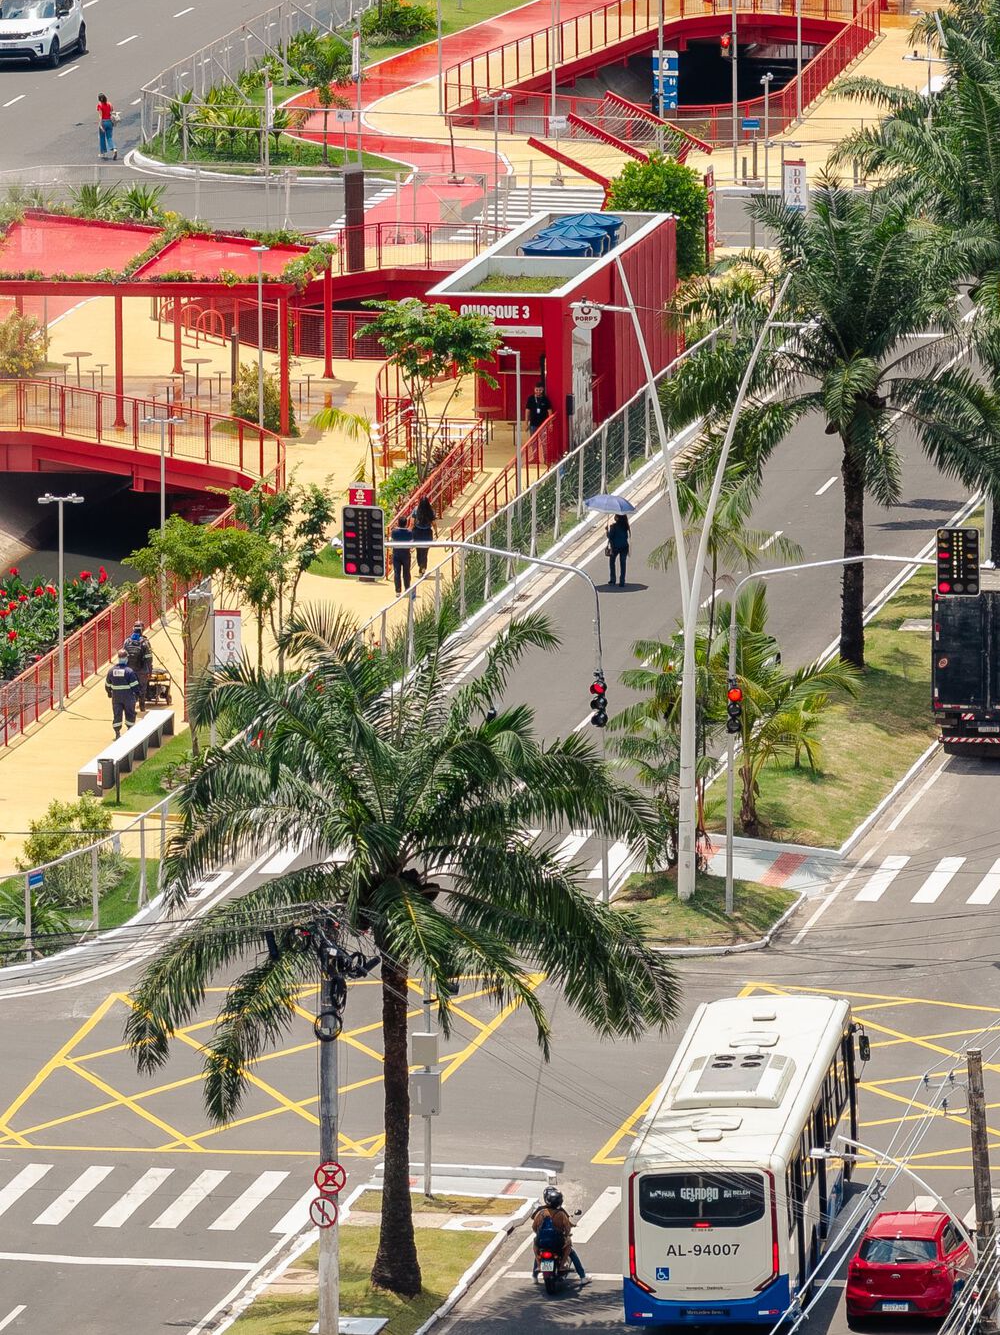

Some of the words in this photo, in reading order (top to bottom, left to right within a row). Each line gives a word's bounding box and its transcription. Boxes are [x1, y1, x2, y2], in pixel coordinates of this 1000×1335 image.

[662, 58, 669, 70] 6
[793, 168, 801, 203] DOCA
[522, 305, 530, 319] 3
[225, 619, 236, 663] DOCA
[666, 1243, 740, 1257] AL-94007
